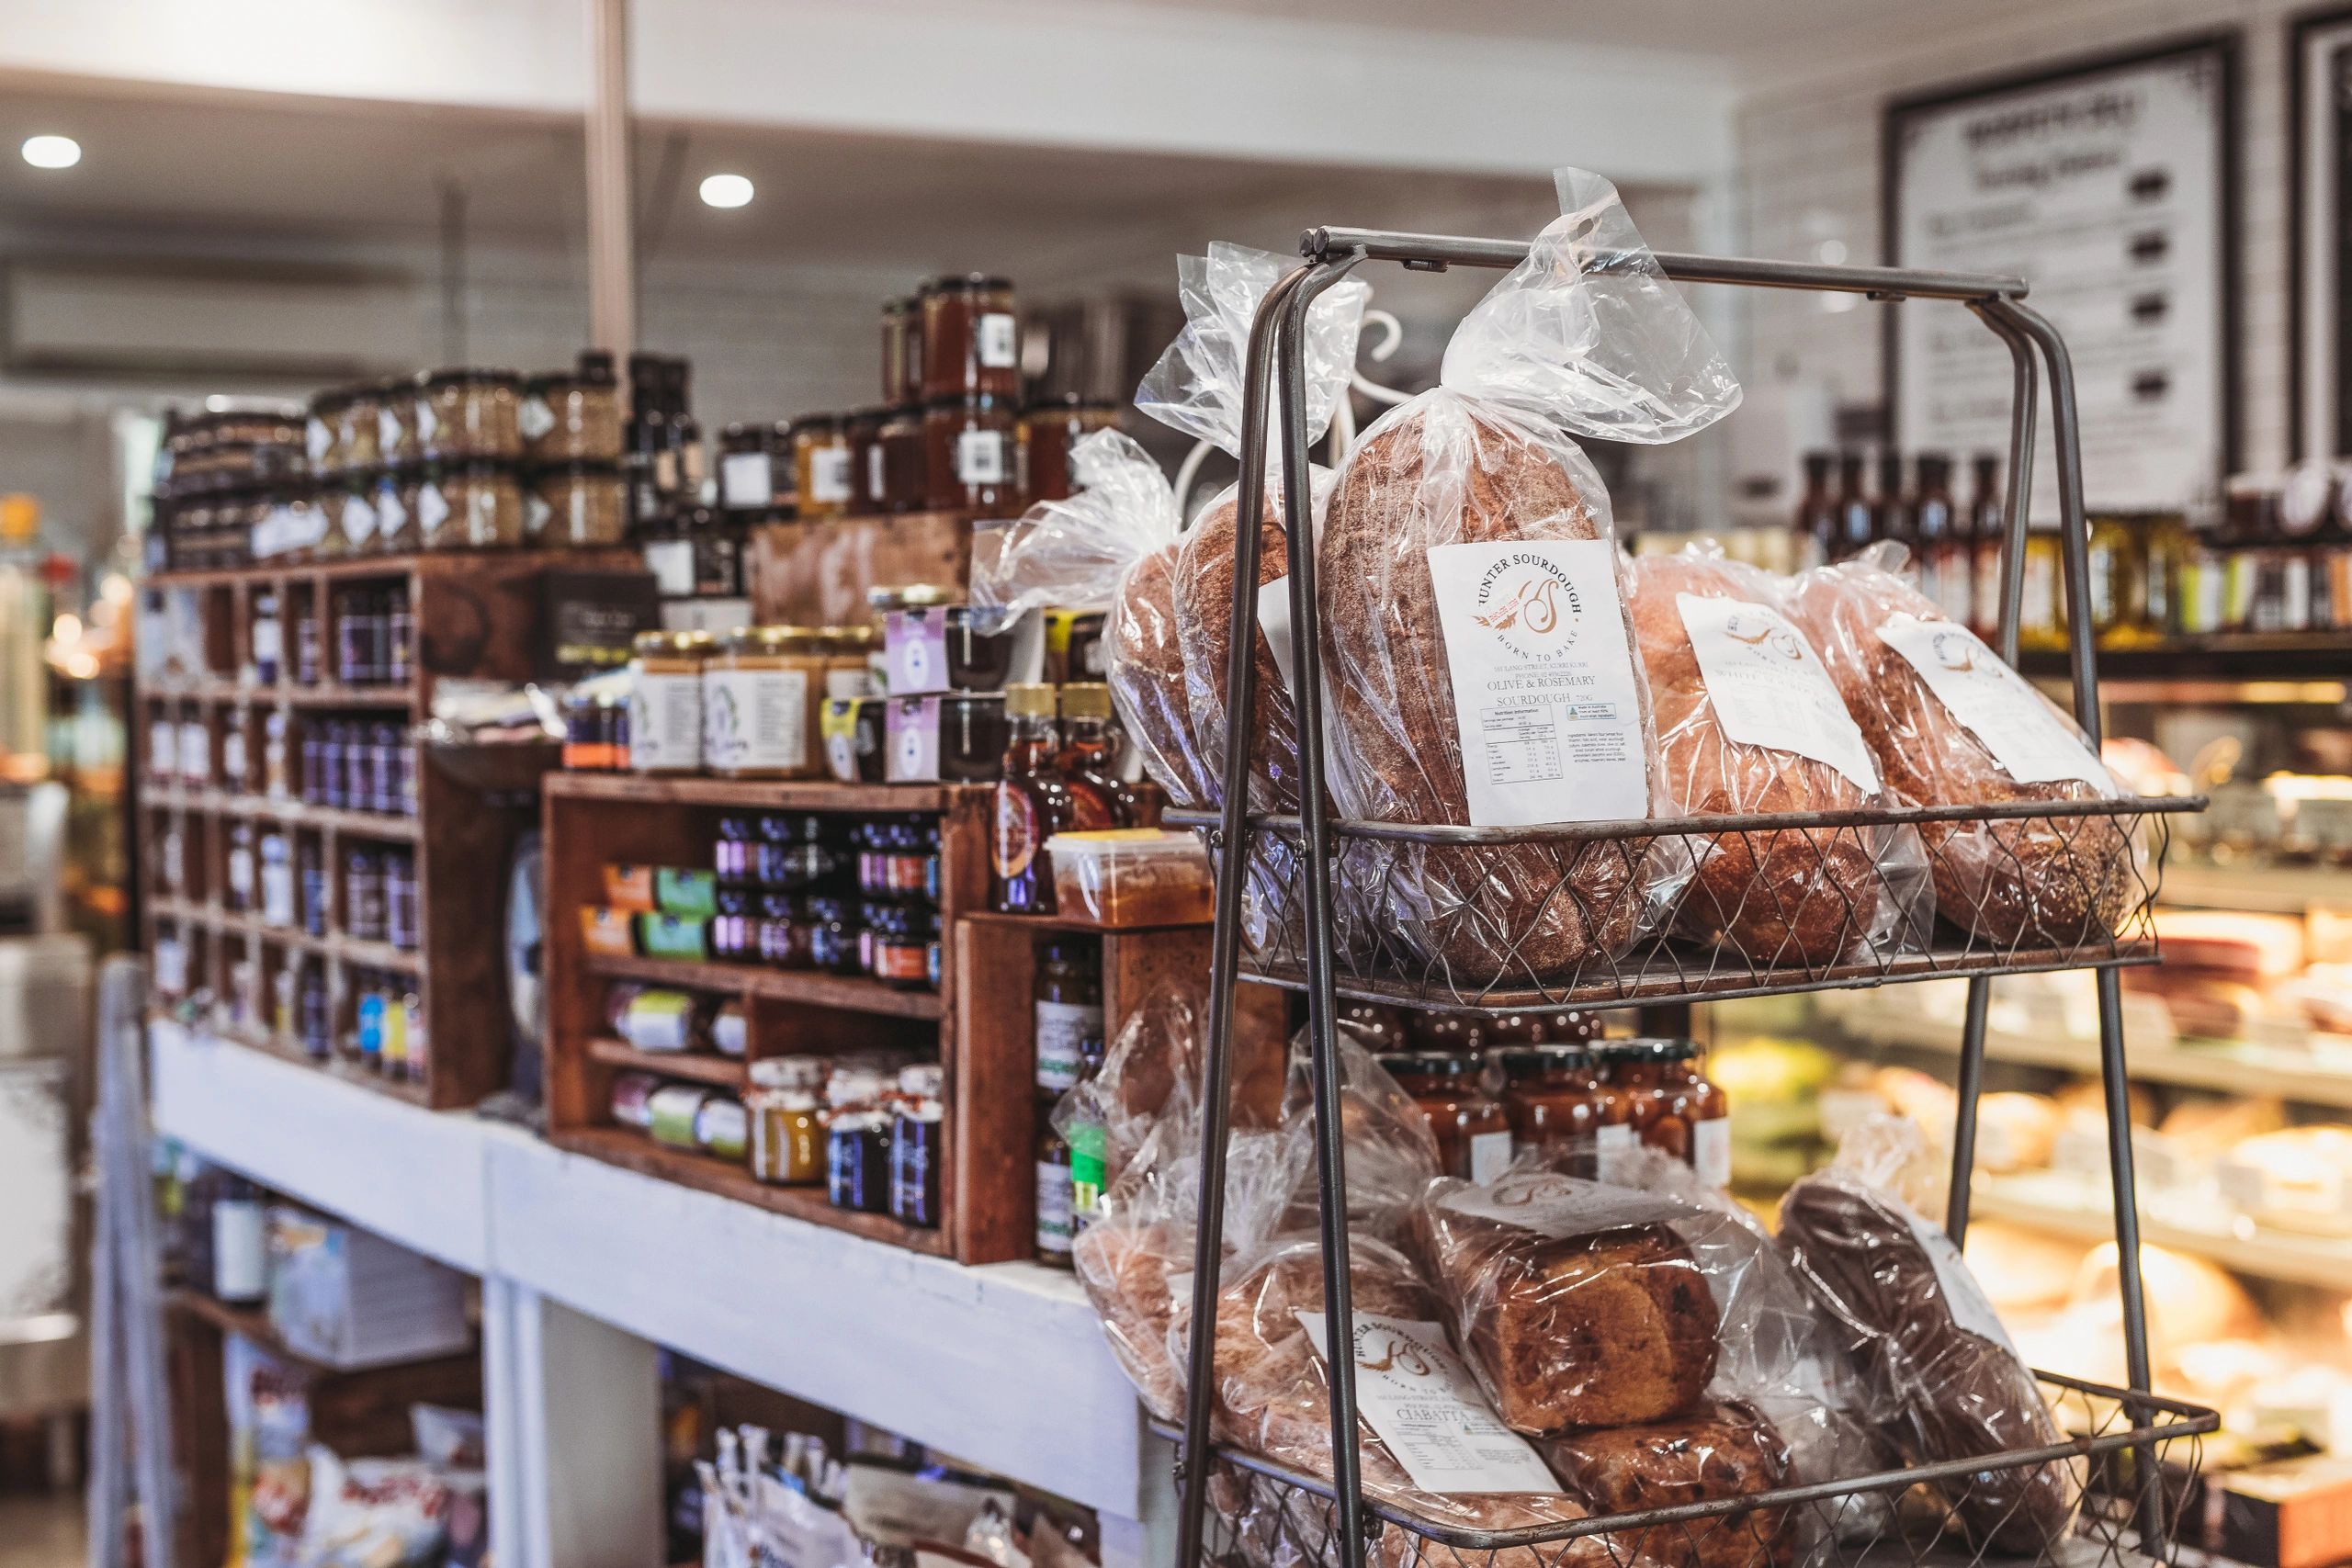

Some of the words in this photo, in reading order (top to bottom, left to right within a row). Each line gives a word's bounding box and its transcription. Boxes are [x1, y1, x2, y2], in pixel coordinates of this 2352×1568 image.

[1512, 554, 1582, 614] SOURDOUGH
[1497, 634, 1530, 660] BORN
[1536, 654, 1551, 662] TO
[1555, 630, 1578, 658] BAKE
[1487, 680, 1524, 691] OLIVE
[1526, 680, 1535, 689] &
[1537, 676, 1596, 689] ROSEMARY
[1497, 694, 1571, 707] SOURDOUGH
[1396, 1408, 1472, 1422] CIABATTA
